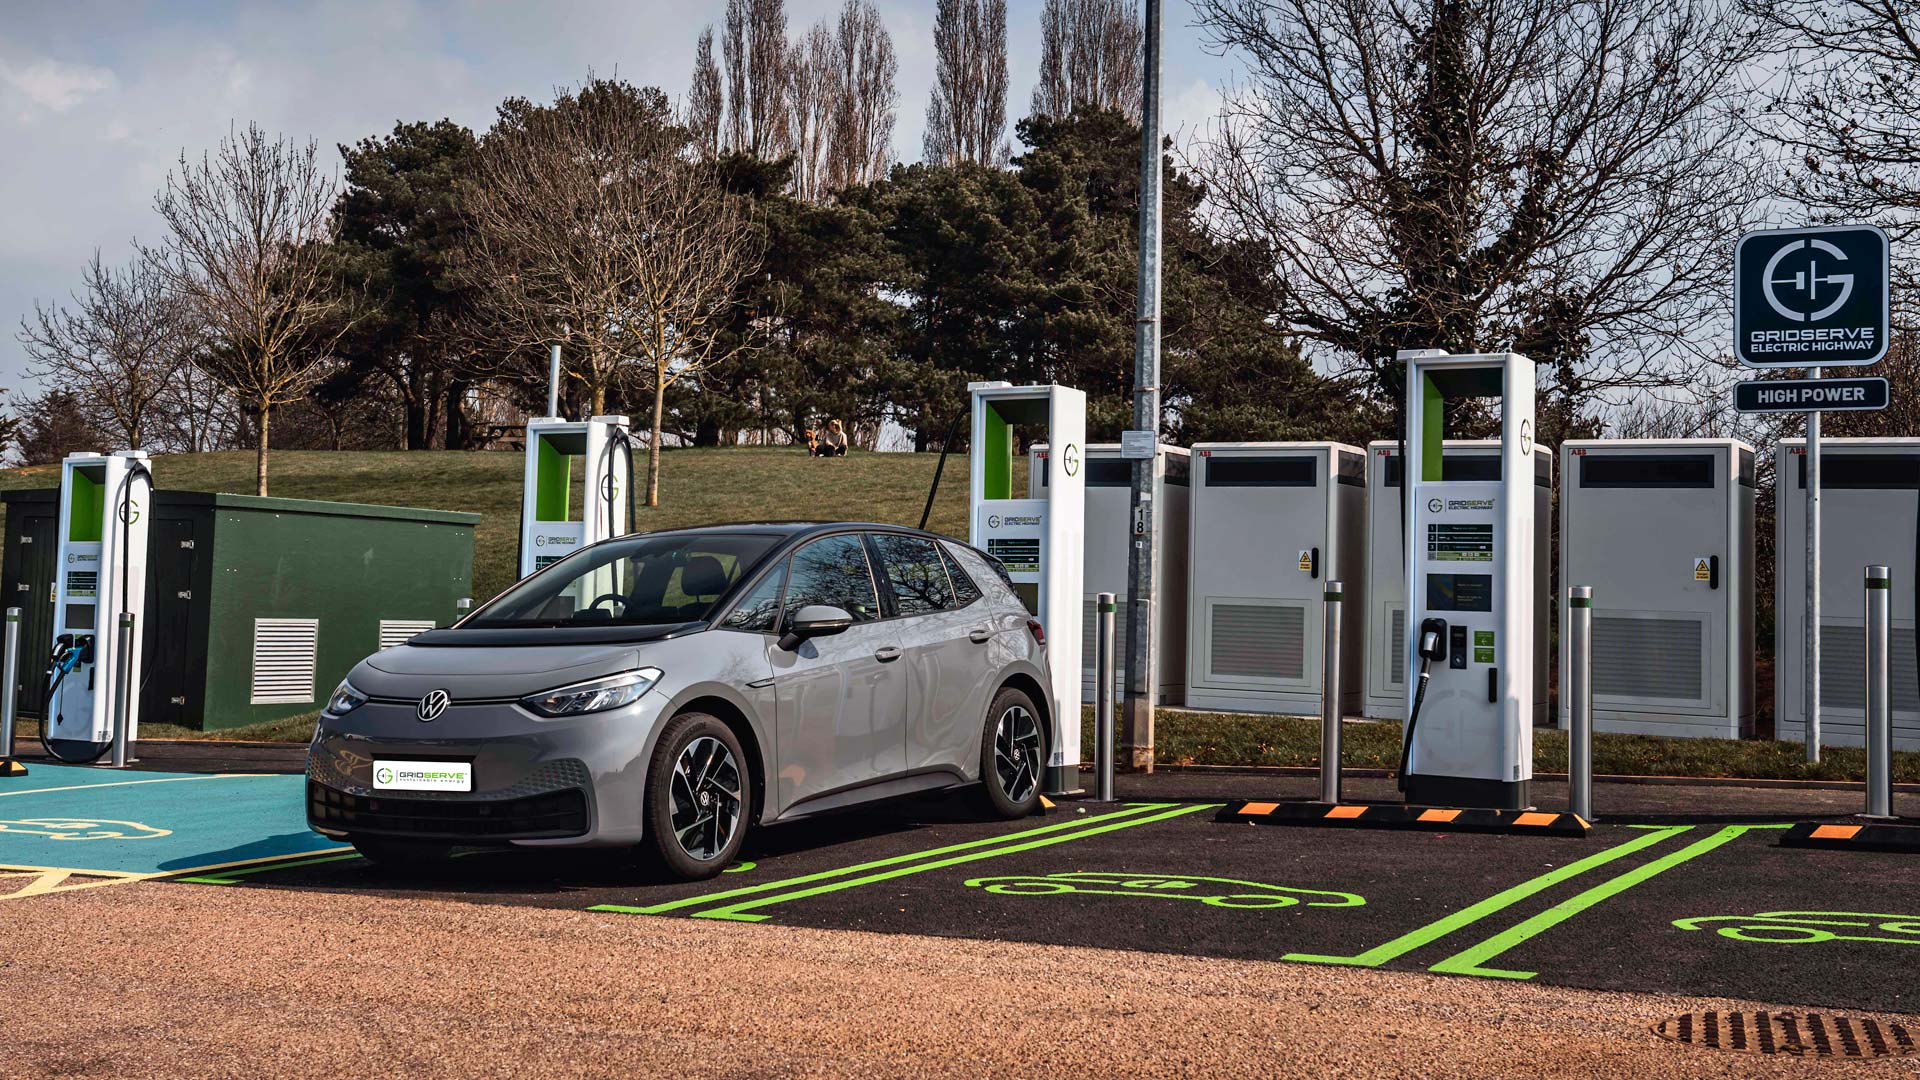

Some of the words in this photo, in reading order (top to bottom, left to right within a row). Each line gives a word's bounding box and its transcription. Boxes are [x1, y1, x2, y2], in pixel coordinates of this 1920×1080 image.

[1751, 328, 1874, 342] GRIDSERVE
[1751, 342, 1809, 352] ELECTRIC
[1812, 340, 1874, 350] HIGHWAY
[1758, 389, 1797, 403] HIGH
[1801, 387, 1865, 402] POWER
